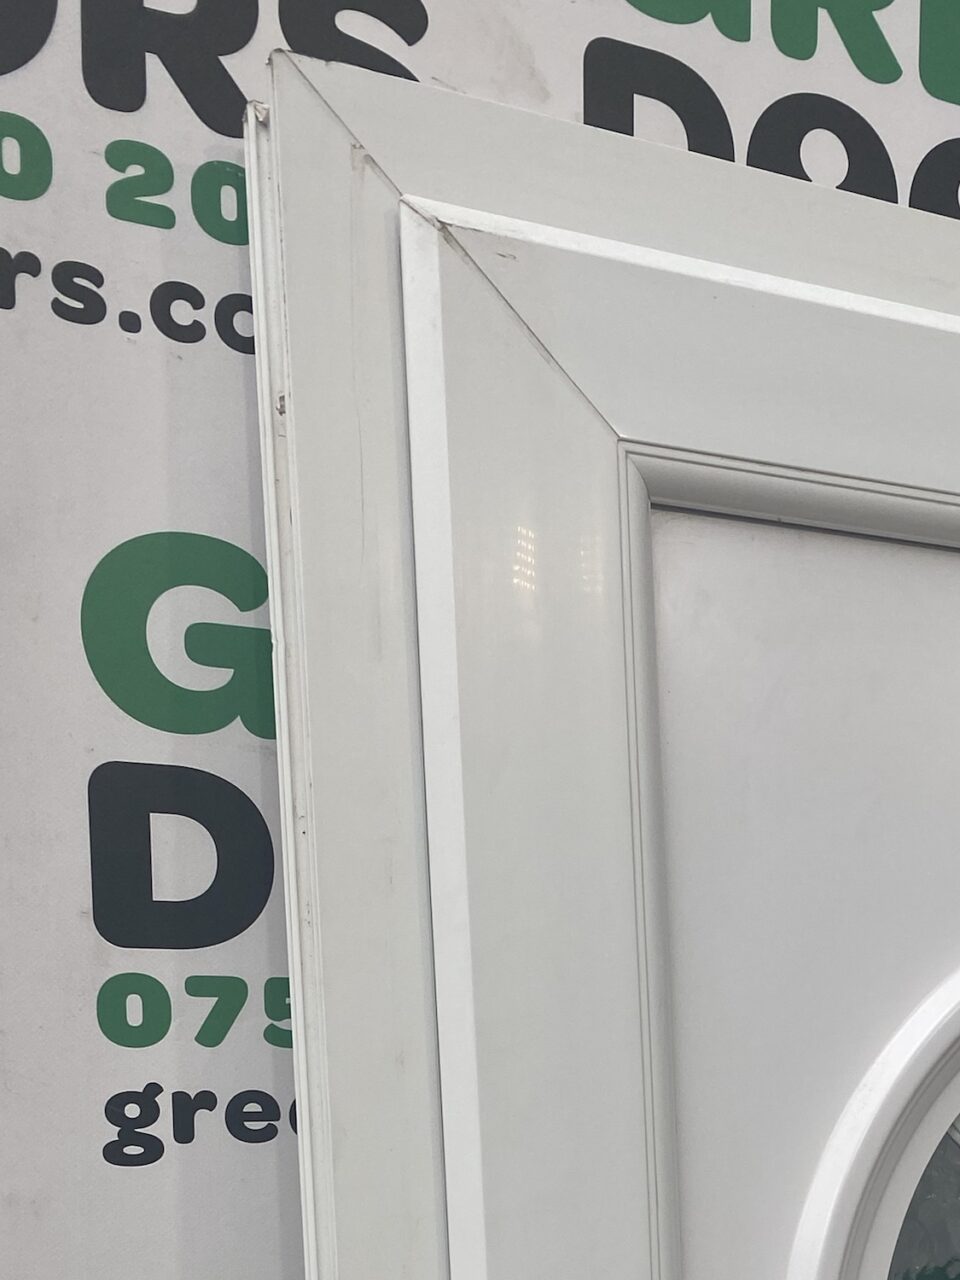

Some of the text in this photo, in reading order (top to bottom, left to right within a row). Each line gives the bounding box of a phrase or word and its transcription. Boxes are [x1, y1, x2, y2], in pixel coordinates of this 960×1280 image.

[81, 531, 277, 740] G
[88, 761, 275, 949] D
[102, 1082, 298, 1166] gre
